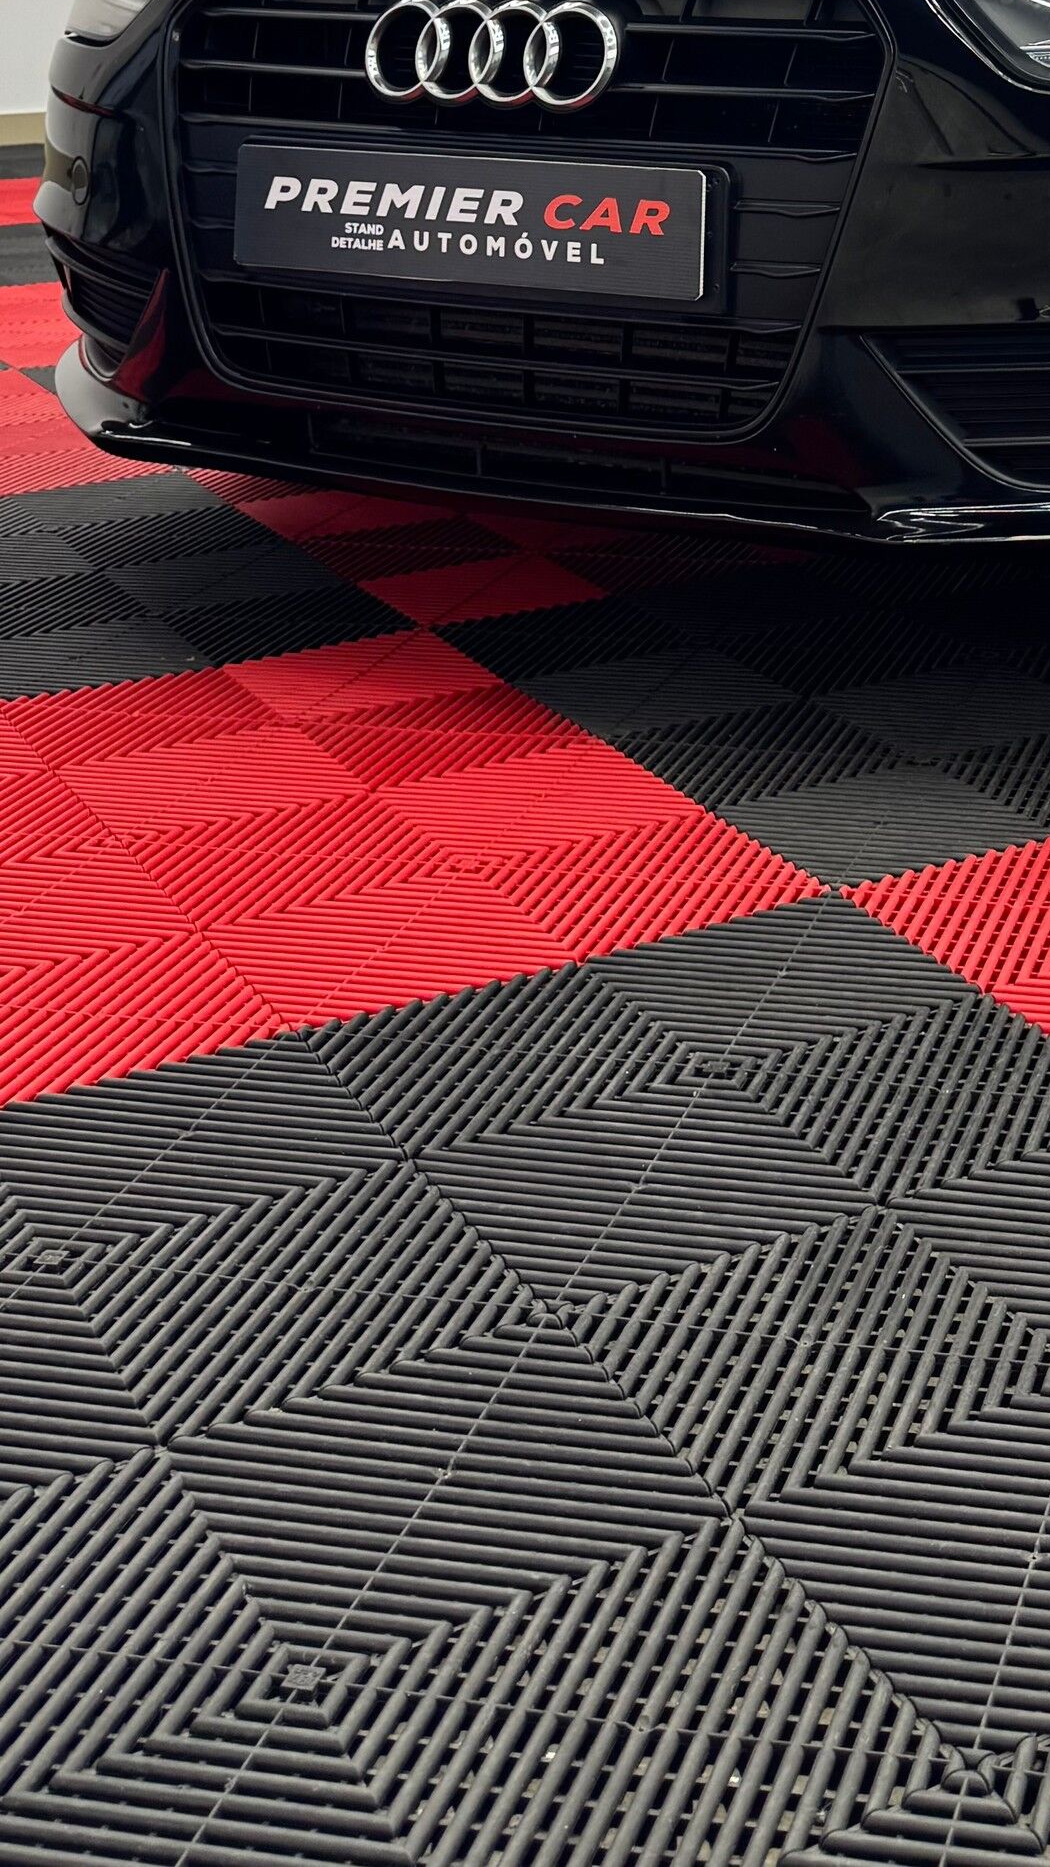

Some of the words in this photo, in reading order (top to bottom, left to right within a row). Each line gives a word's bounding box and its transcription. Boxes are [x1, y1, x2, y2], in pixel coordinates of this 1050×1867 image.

[264, 175, 524, 226] PREMIER
[543, 194, 672, 236] CAR
[344, 221, 385, 236] STAND
[331, 236, 384, 252] DETALHE
[386, 228, 606, 265] AUTOMÓVEL
